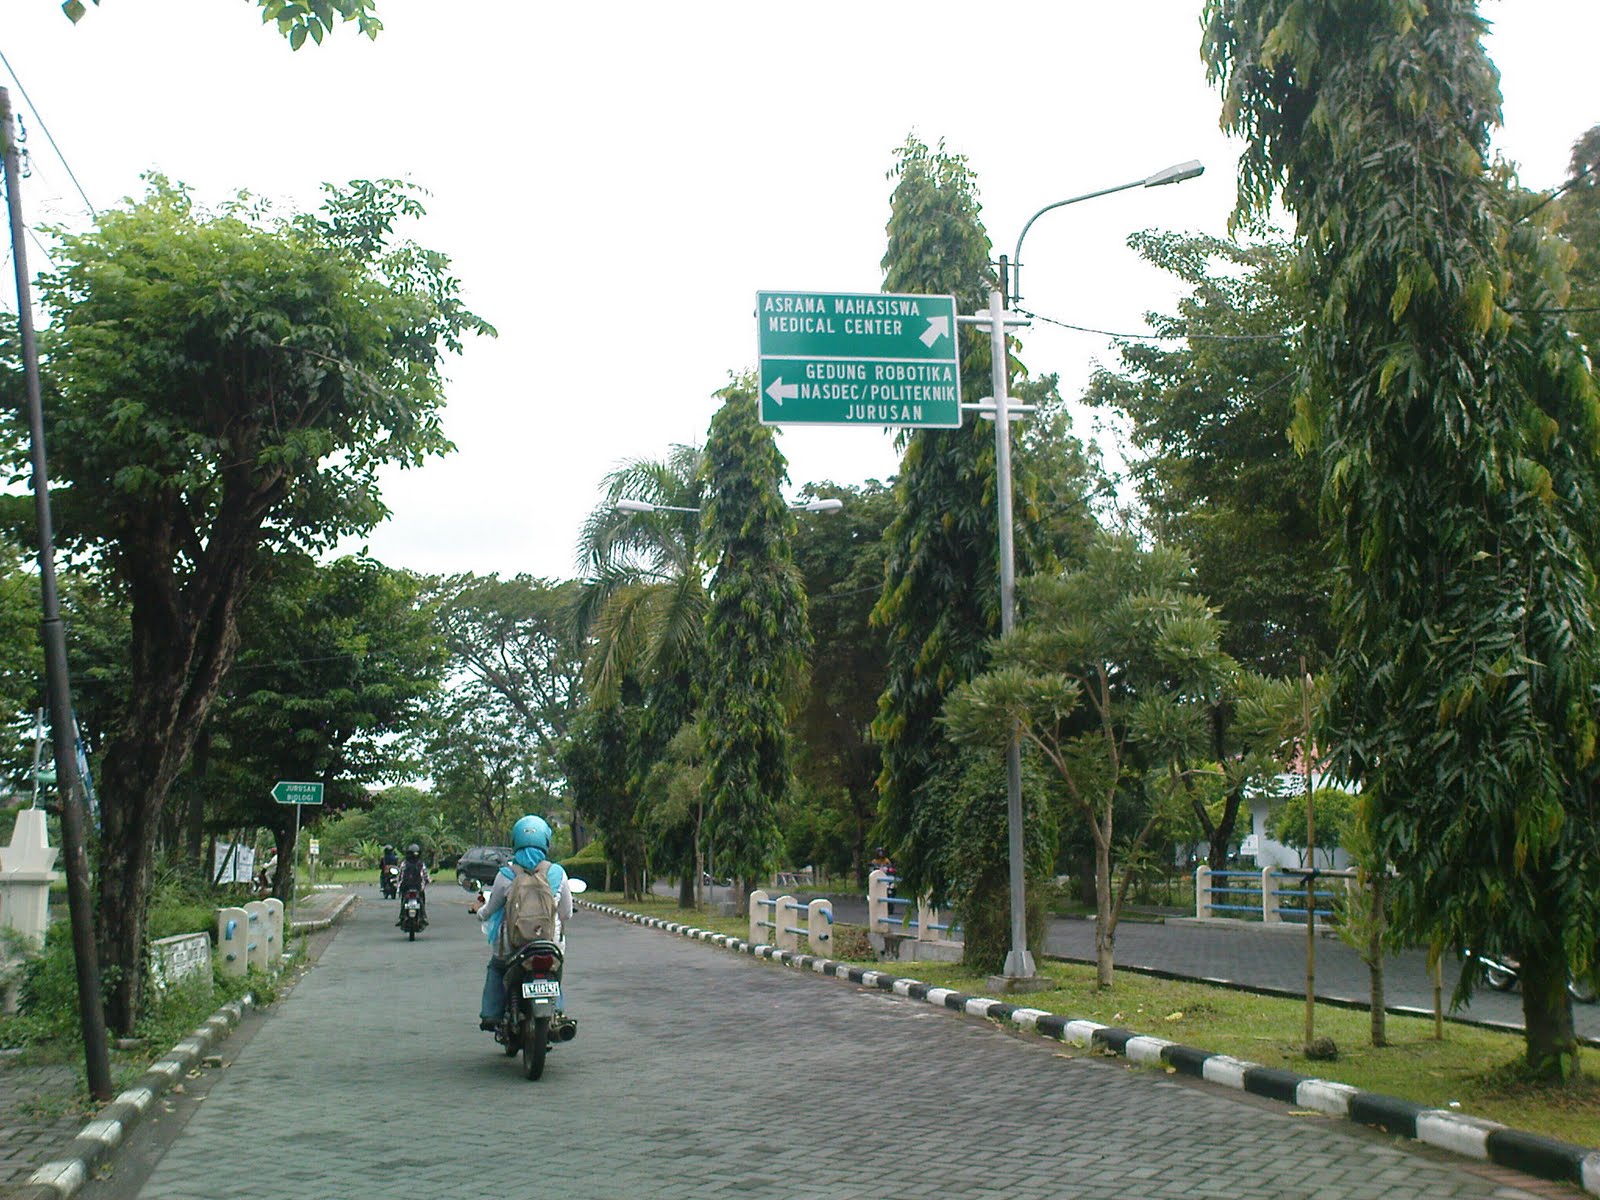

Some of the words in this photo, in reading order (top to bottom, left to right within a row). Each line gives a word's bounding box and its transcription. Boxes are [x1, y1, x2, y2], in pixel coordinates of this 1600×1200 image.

[764, 297, 825, 314] ASRAMA
[835, 300, 920, 316] MAHASISWA
[769, 317, 835, 334] MEDICAL
[844, 319, 902, 336] CENTER
[806, 363, 866, 380] GEDUNG
[875, 364, 952, 382] ROBOTIKA
[801, 383, 955, 401] NASDEC/POLITEKNIK
[845, 404, 923, 421] JURUSAN
